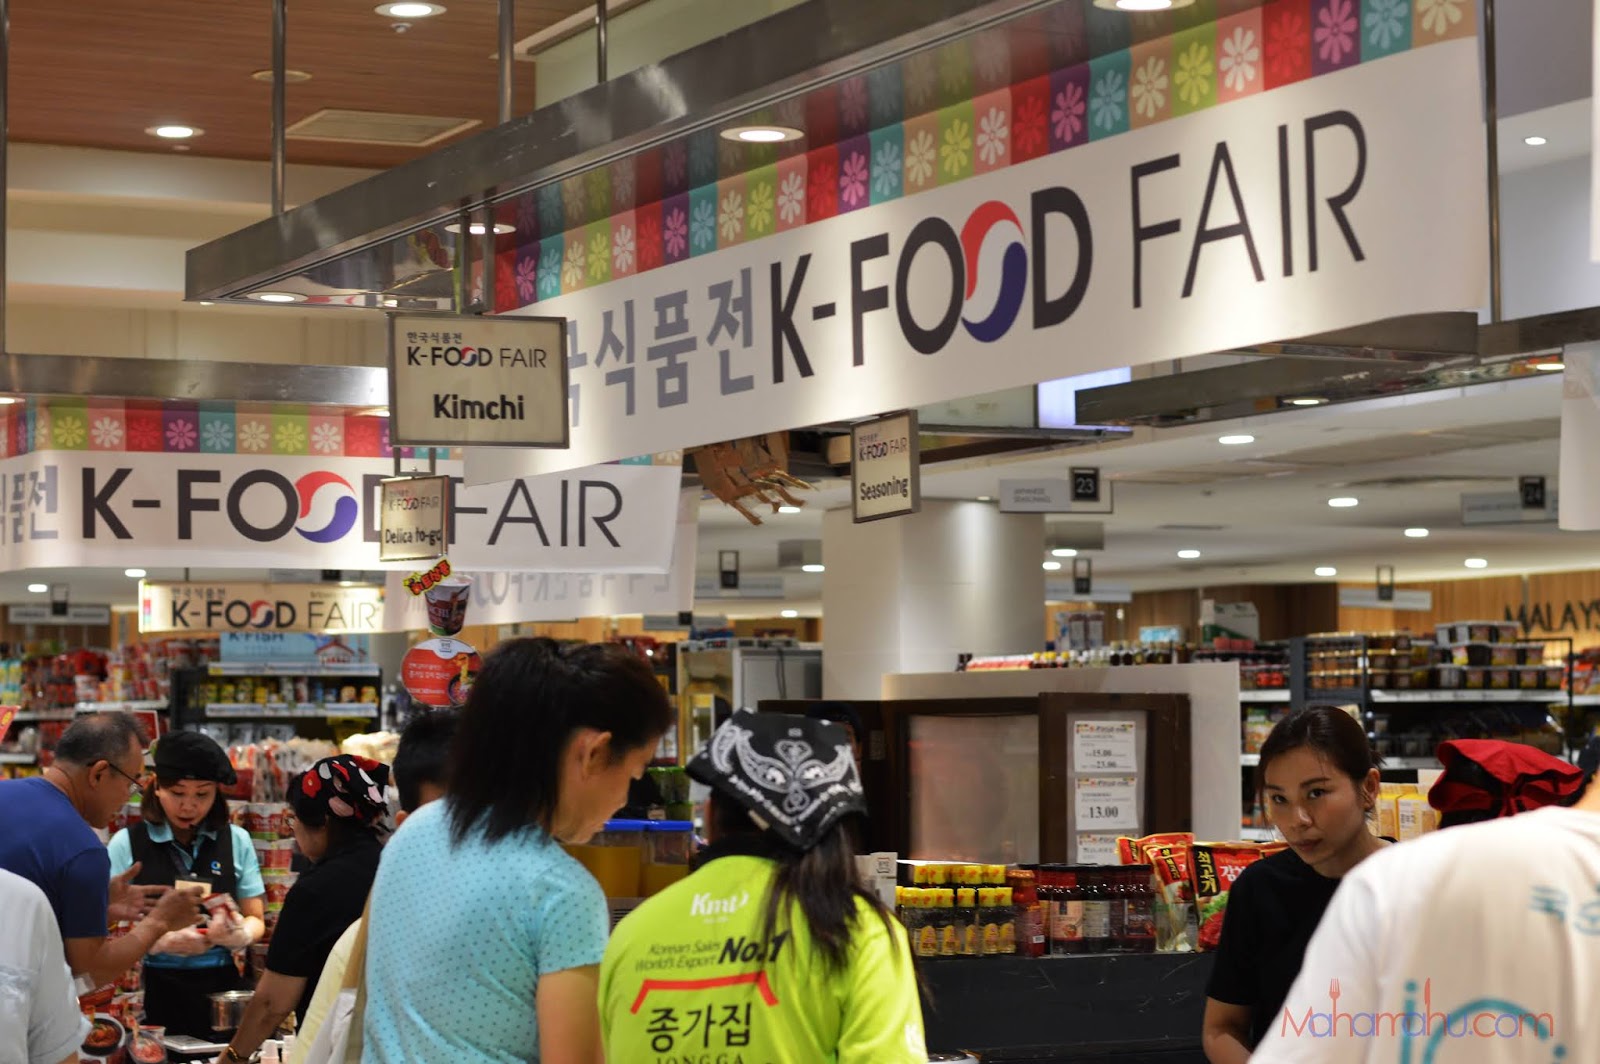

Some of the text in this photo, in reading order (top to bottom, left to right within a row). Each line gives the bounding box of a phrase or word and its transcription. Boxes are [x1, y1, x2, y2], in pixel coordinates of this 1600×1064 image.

[771, 110, 1367, 384] K-FOOD FAIR
[407, 332, 463, 345] 한국식품전
[407, 346, 547, 368] K-FOOD FAIR
[433, 394, 525, 420] Kimchi
[889, 437, 907, 455] FAIR
[860, 475, 908, 501] Seasoning
[1076, 478, 1095, 494] 23
[385, 528, 413, 544] Delica
[171, 599, 375, 629] K-FOOD FAIR
[1089, 806, 1119, 819] 13.00
[1197, 851, 1217, 893] 쇠고기
[718, 930, 791, 964] No.1
[647, 1002, 752, 1052] 종가집
